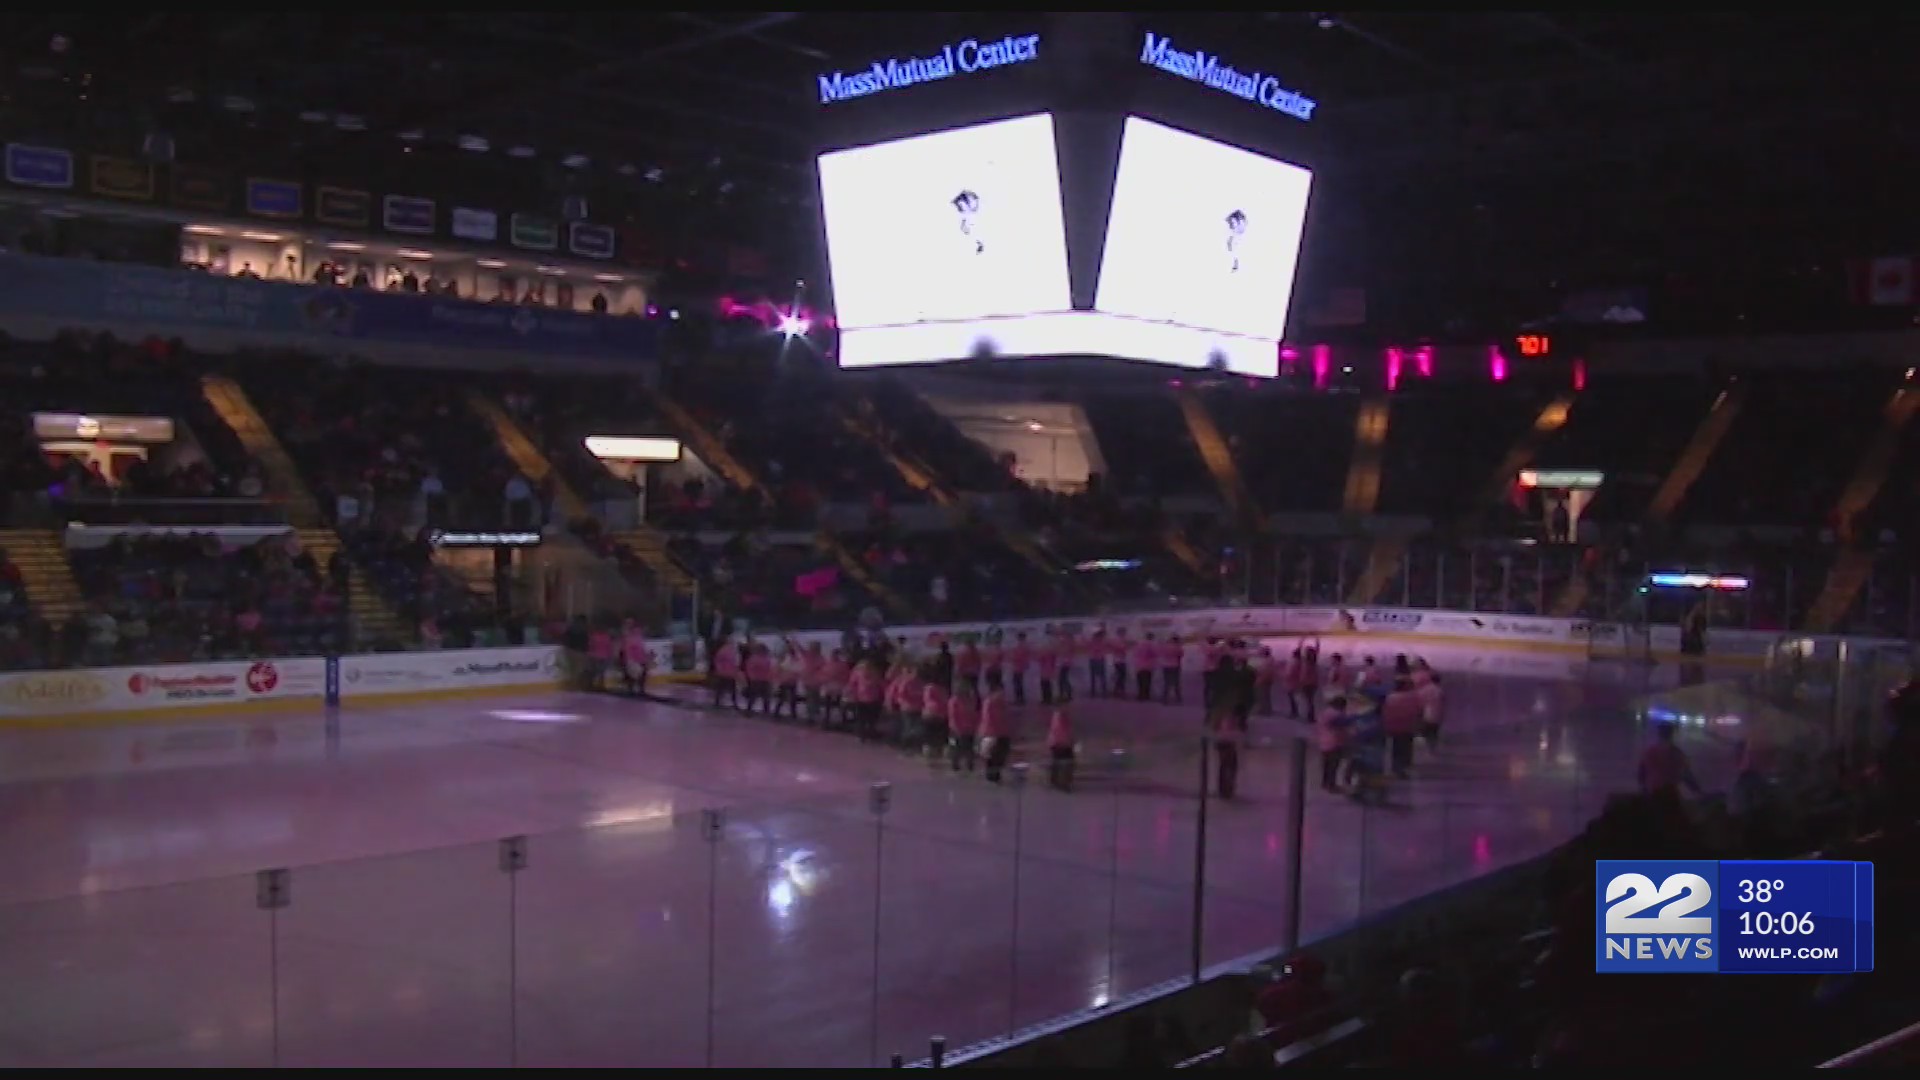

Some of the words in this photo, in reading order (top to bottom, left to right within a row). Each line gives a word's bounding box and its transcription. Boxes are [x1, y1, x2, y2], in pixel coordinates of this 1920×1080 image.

[818, 43, 954, 103] MassMutual
[956, 33, 1040, 72] Center
[1140, 31, 1261, 101] MassMutual
[1258, 75, 1317, 120] Center
